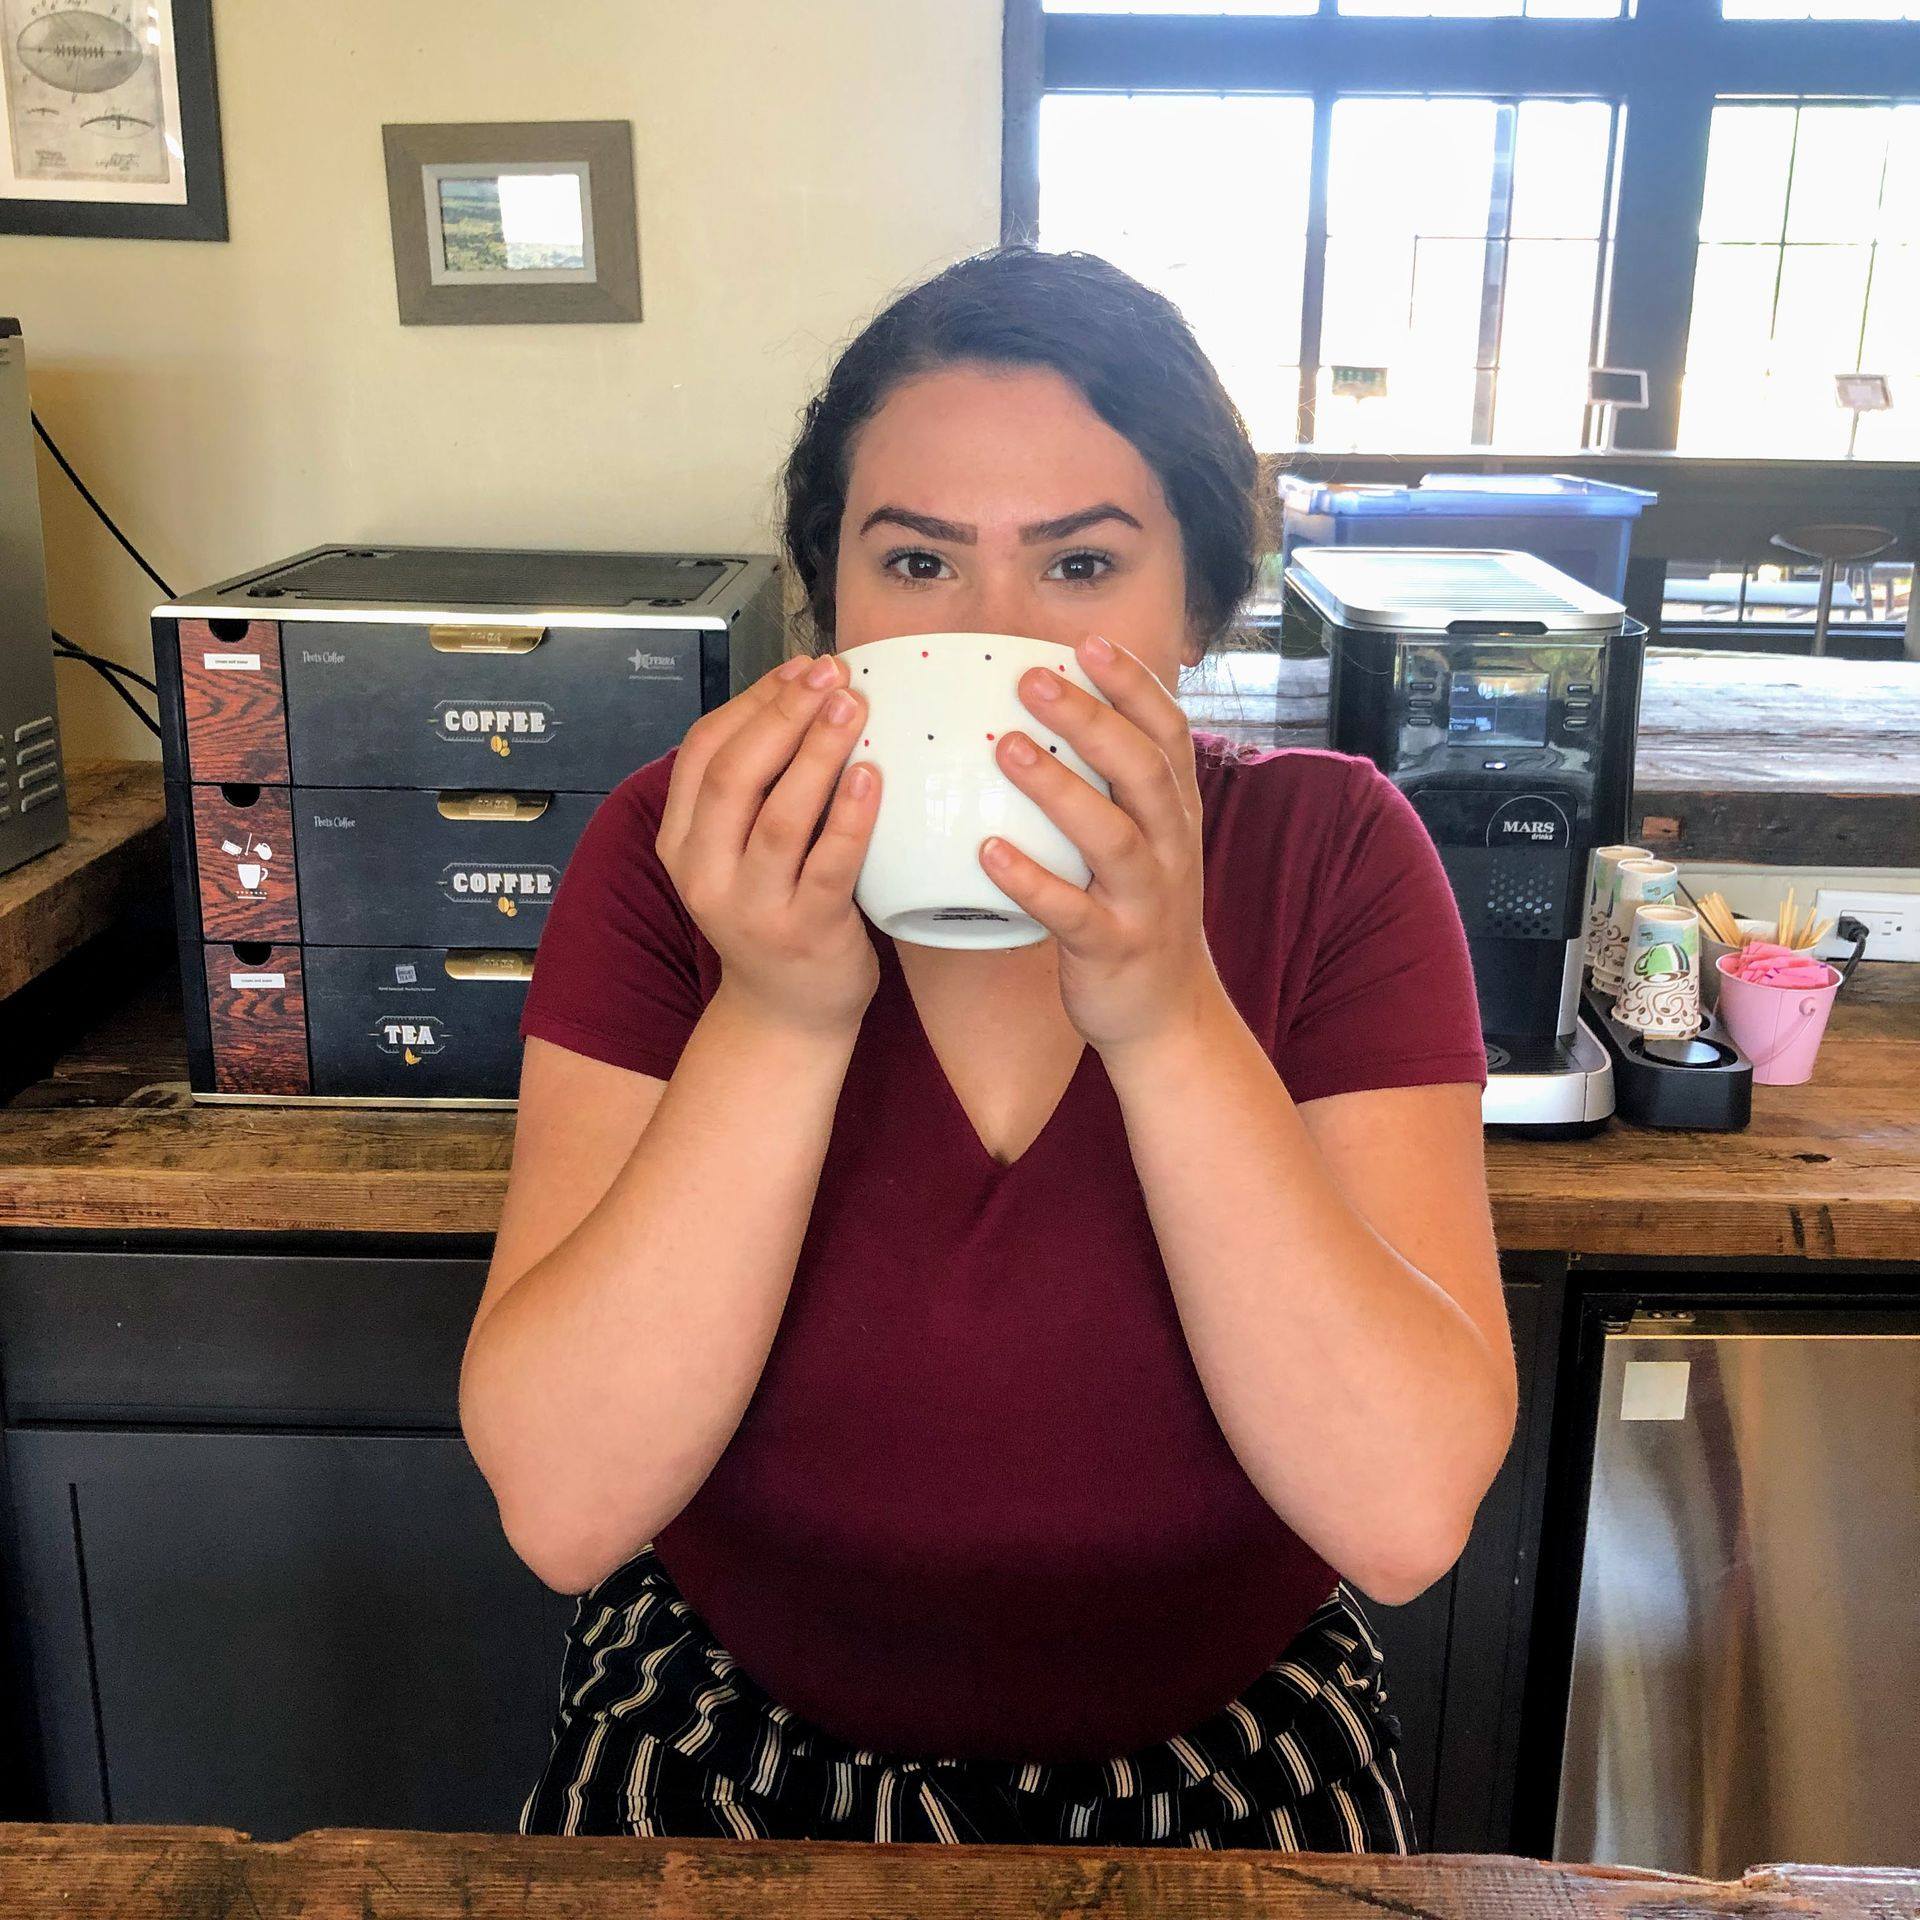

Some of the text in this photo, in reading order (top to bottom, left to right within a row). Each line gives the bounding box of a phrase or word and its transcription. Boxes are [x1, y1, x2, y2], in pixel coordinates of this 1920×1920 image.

[445, 710, 546, 733] COFFEE
[1503, 821, 1555, 833] MARS
[1531, 833, 1553, 841] drinks
[453, 873, 553, 894] COFFEE
[384, 1025, 435, 1045] TEA
